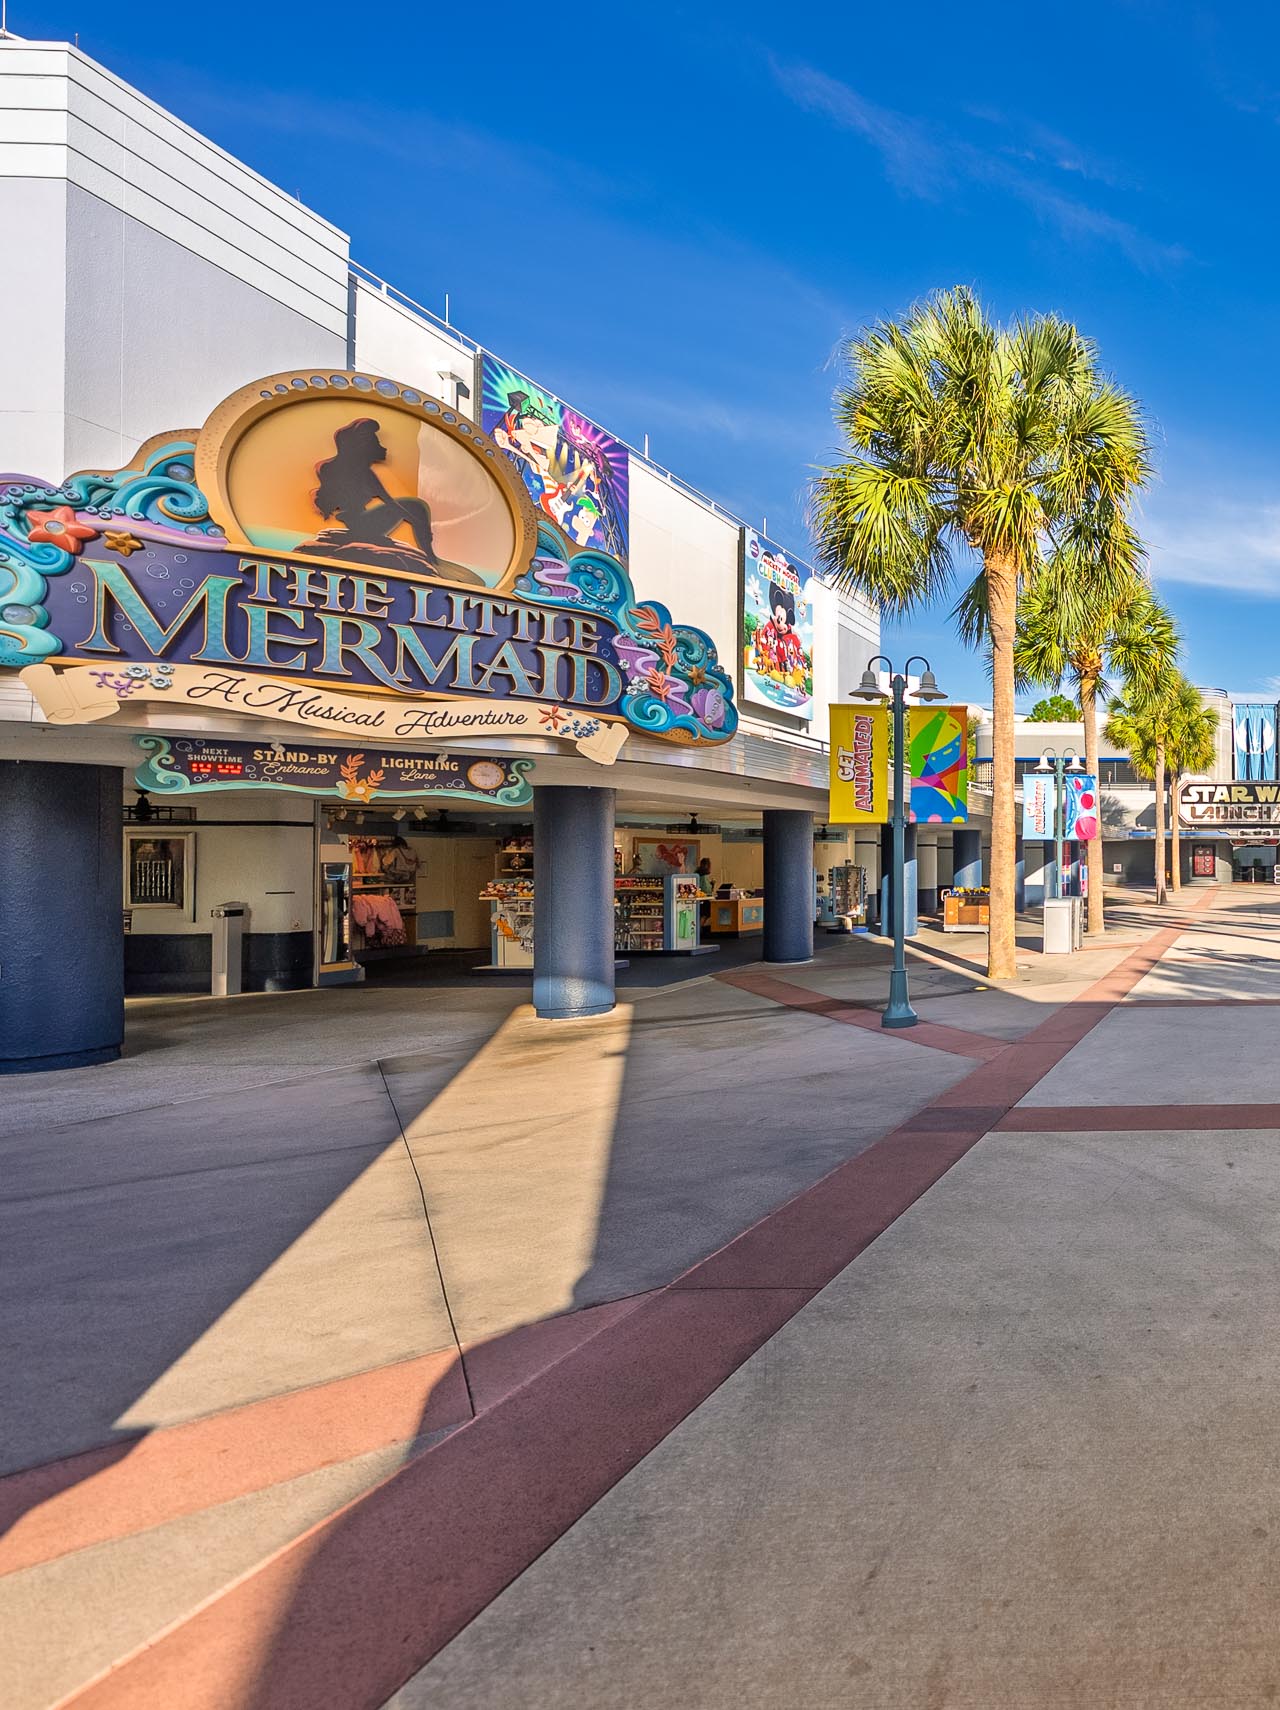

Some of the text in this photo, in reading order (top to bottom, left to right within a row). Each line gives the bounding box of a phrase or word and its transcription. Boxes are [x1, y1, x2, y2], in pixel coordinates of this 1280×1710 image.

[238, 559, 602, 654] THE LITTLE
[75, 558, 623, 706] MERMAID
[186, 672, 528, 736] A Musical Adventure
[187, 753, 243, 763] SHOWTIME
[202, 747, 229, 755] NEXT
[253, 749, 338, 765] STAND-BY
[259, 761, 330, 776] Entrance
[381, 757, 459, 772] LIGHTNING
[837, 745, 855, 782] GET
[853, 714, 874, 813] ANIMATED!
[400, 769, 437, 782] Lane
[1181, 785, 1253, 803] STAR
[1190, 805, 1271, 820] LAUNCH
